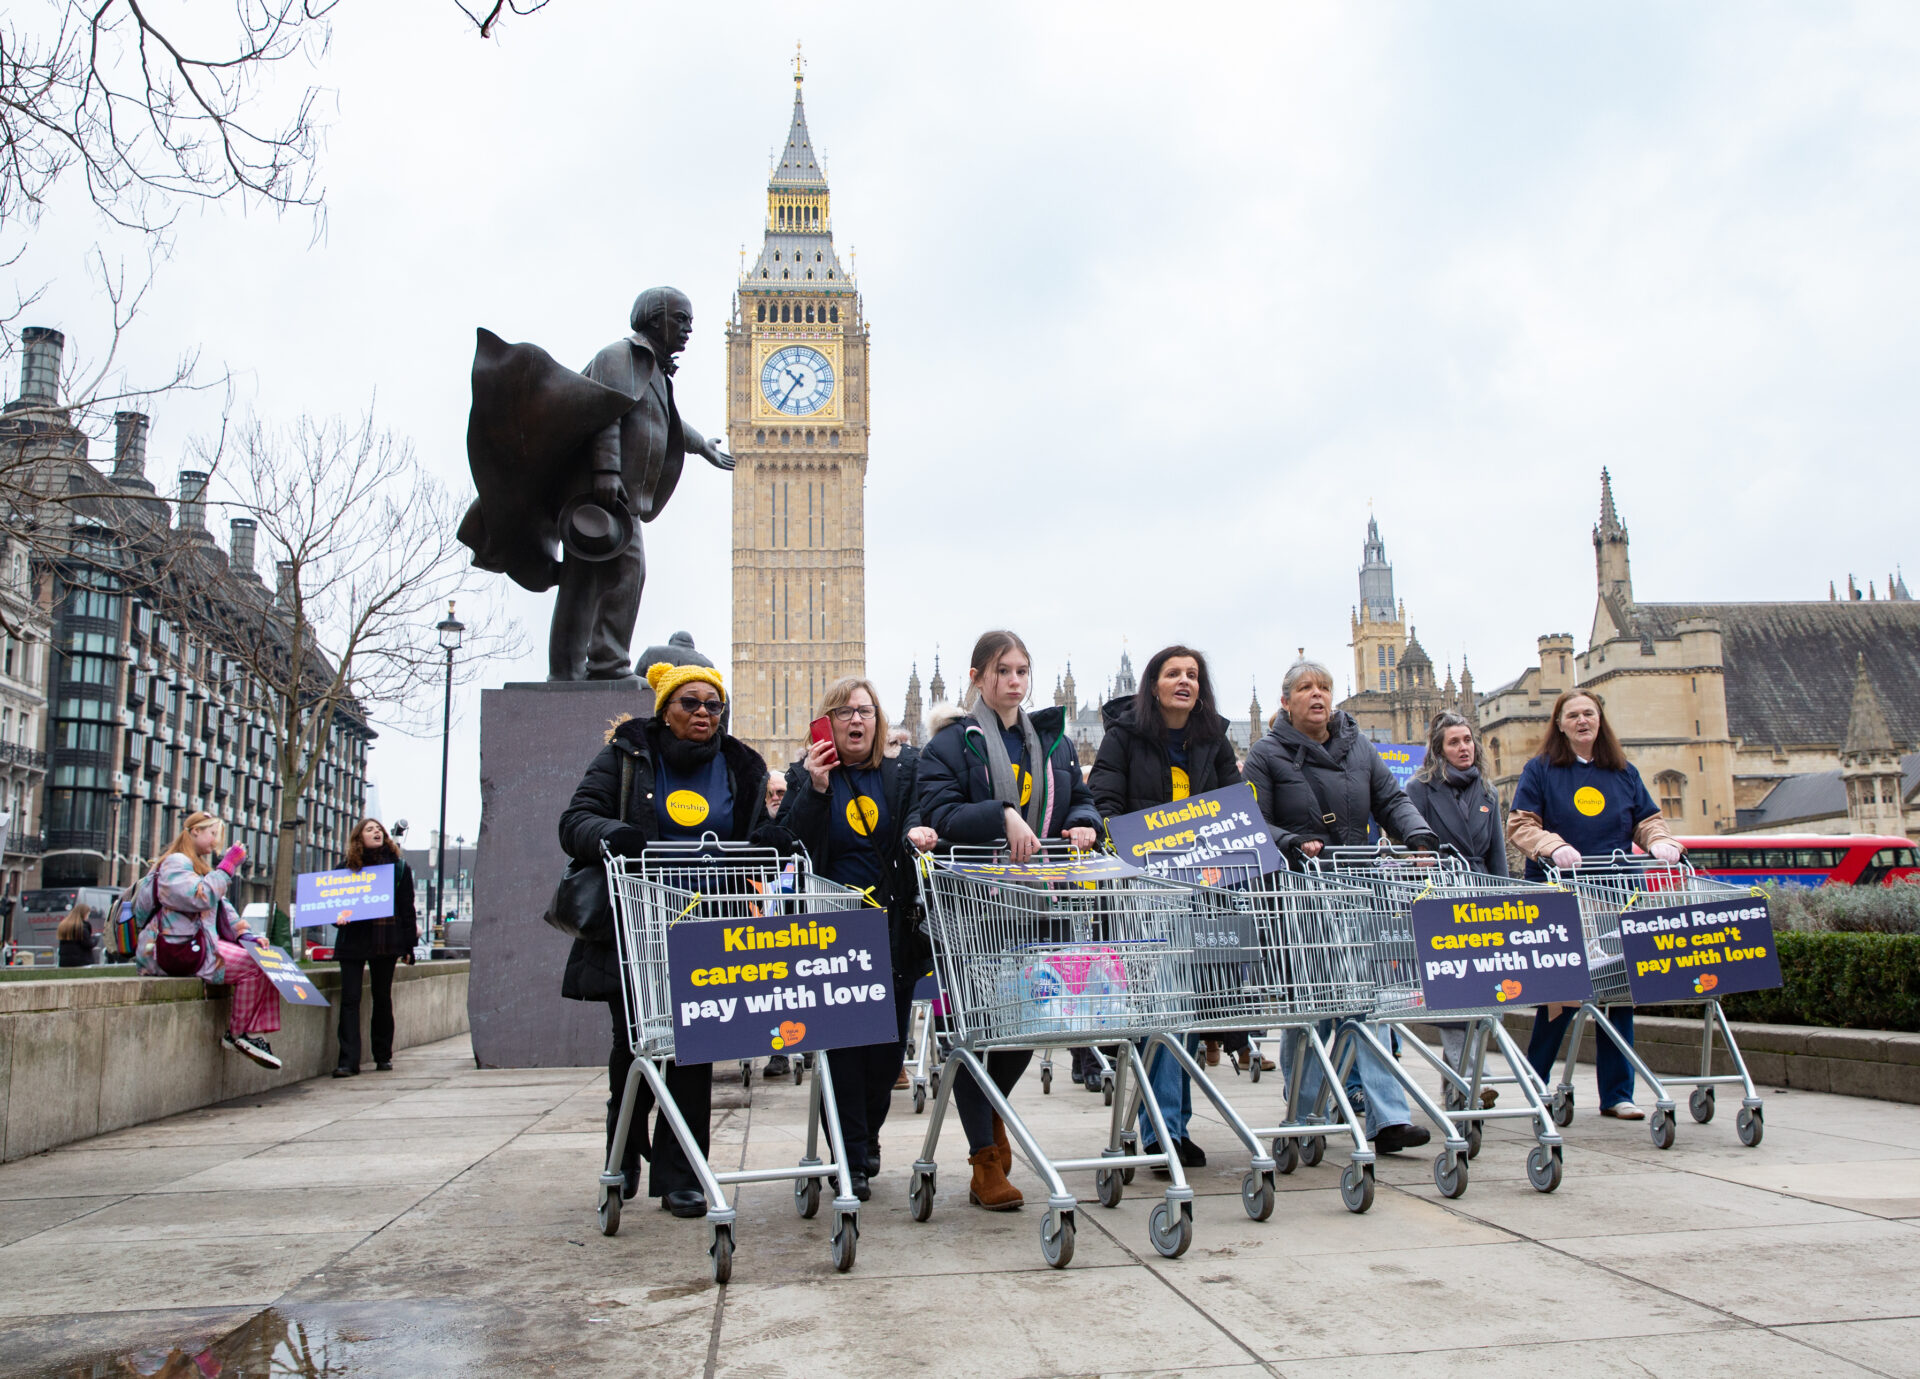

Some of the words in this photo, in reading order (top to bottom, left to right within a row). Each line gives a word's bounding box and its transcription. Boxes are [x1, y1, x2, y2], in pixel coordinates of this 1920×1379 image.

[1378, 750, 1409, 764] ship
[670, 801, 706, 813] Kinship
[1144, 798, 1221, 831] Kinship
[1132, 829, 1195, 857] carers
[1199, 811, 1252, 838] can't
[1172, 838, 1222, 869] with
[1222, 832, 1267, 853] love
[315, 871, 377, 887] Kinship
[320, 884, 371, 897] carers
[300, 897, 359, 912] matter
[362, 894, 390, 904] too
[1452, 900, 1540, 924] Kinship
[1621, 912, 1689, 936] Rachel
[1691, 906, 1767, 927] Reeves:
[723, 921, 837, 952] Kinship
[1431, 931, 1505, 950] carers
[1509, 923, 1569, 946] can't
[1653, 933, 1687, 951] We
[1691, 926, 1742, 946] can't
[690, 960, 788, 986] carers
[795, 948, 872, 977] can't
[1425, 959, 1468, 981] pay
[1473, 951, 1528, 973] with
[1532, 950, 1581, 969] love
[1636, 957, 1671, 977] pay
[1675, 948, 1722, 968] with
[1724, 946, 1767, 962] love
[680, 997, 738, 1026] pay
[745, 985, 816, 1014] with
[823, 982, 886, 1006] love
